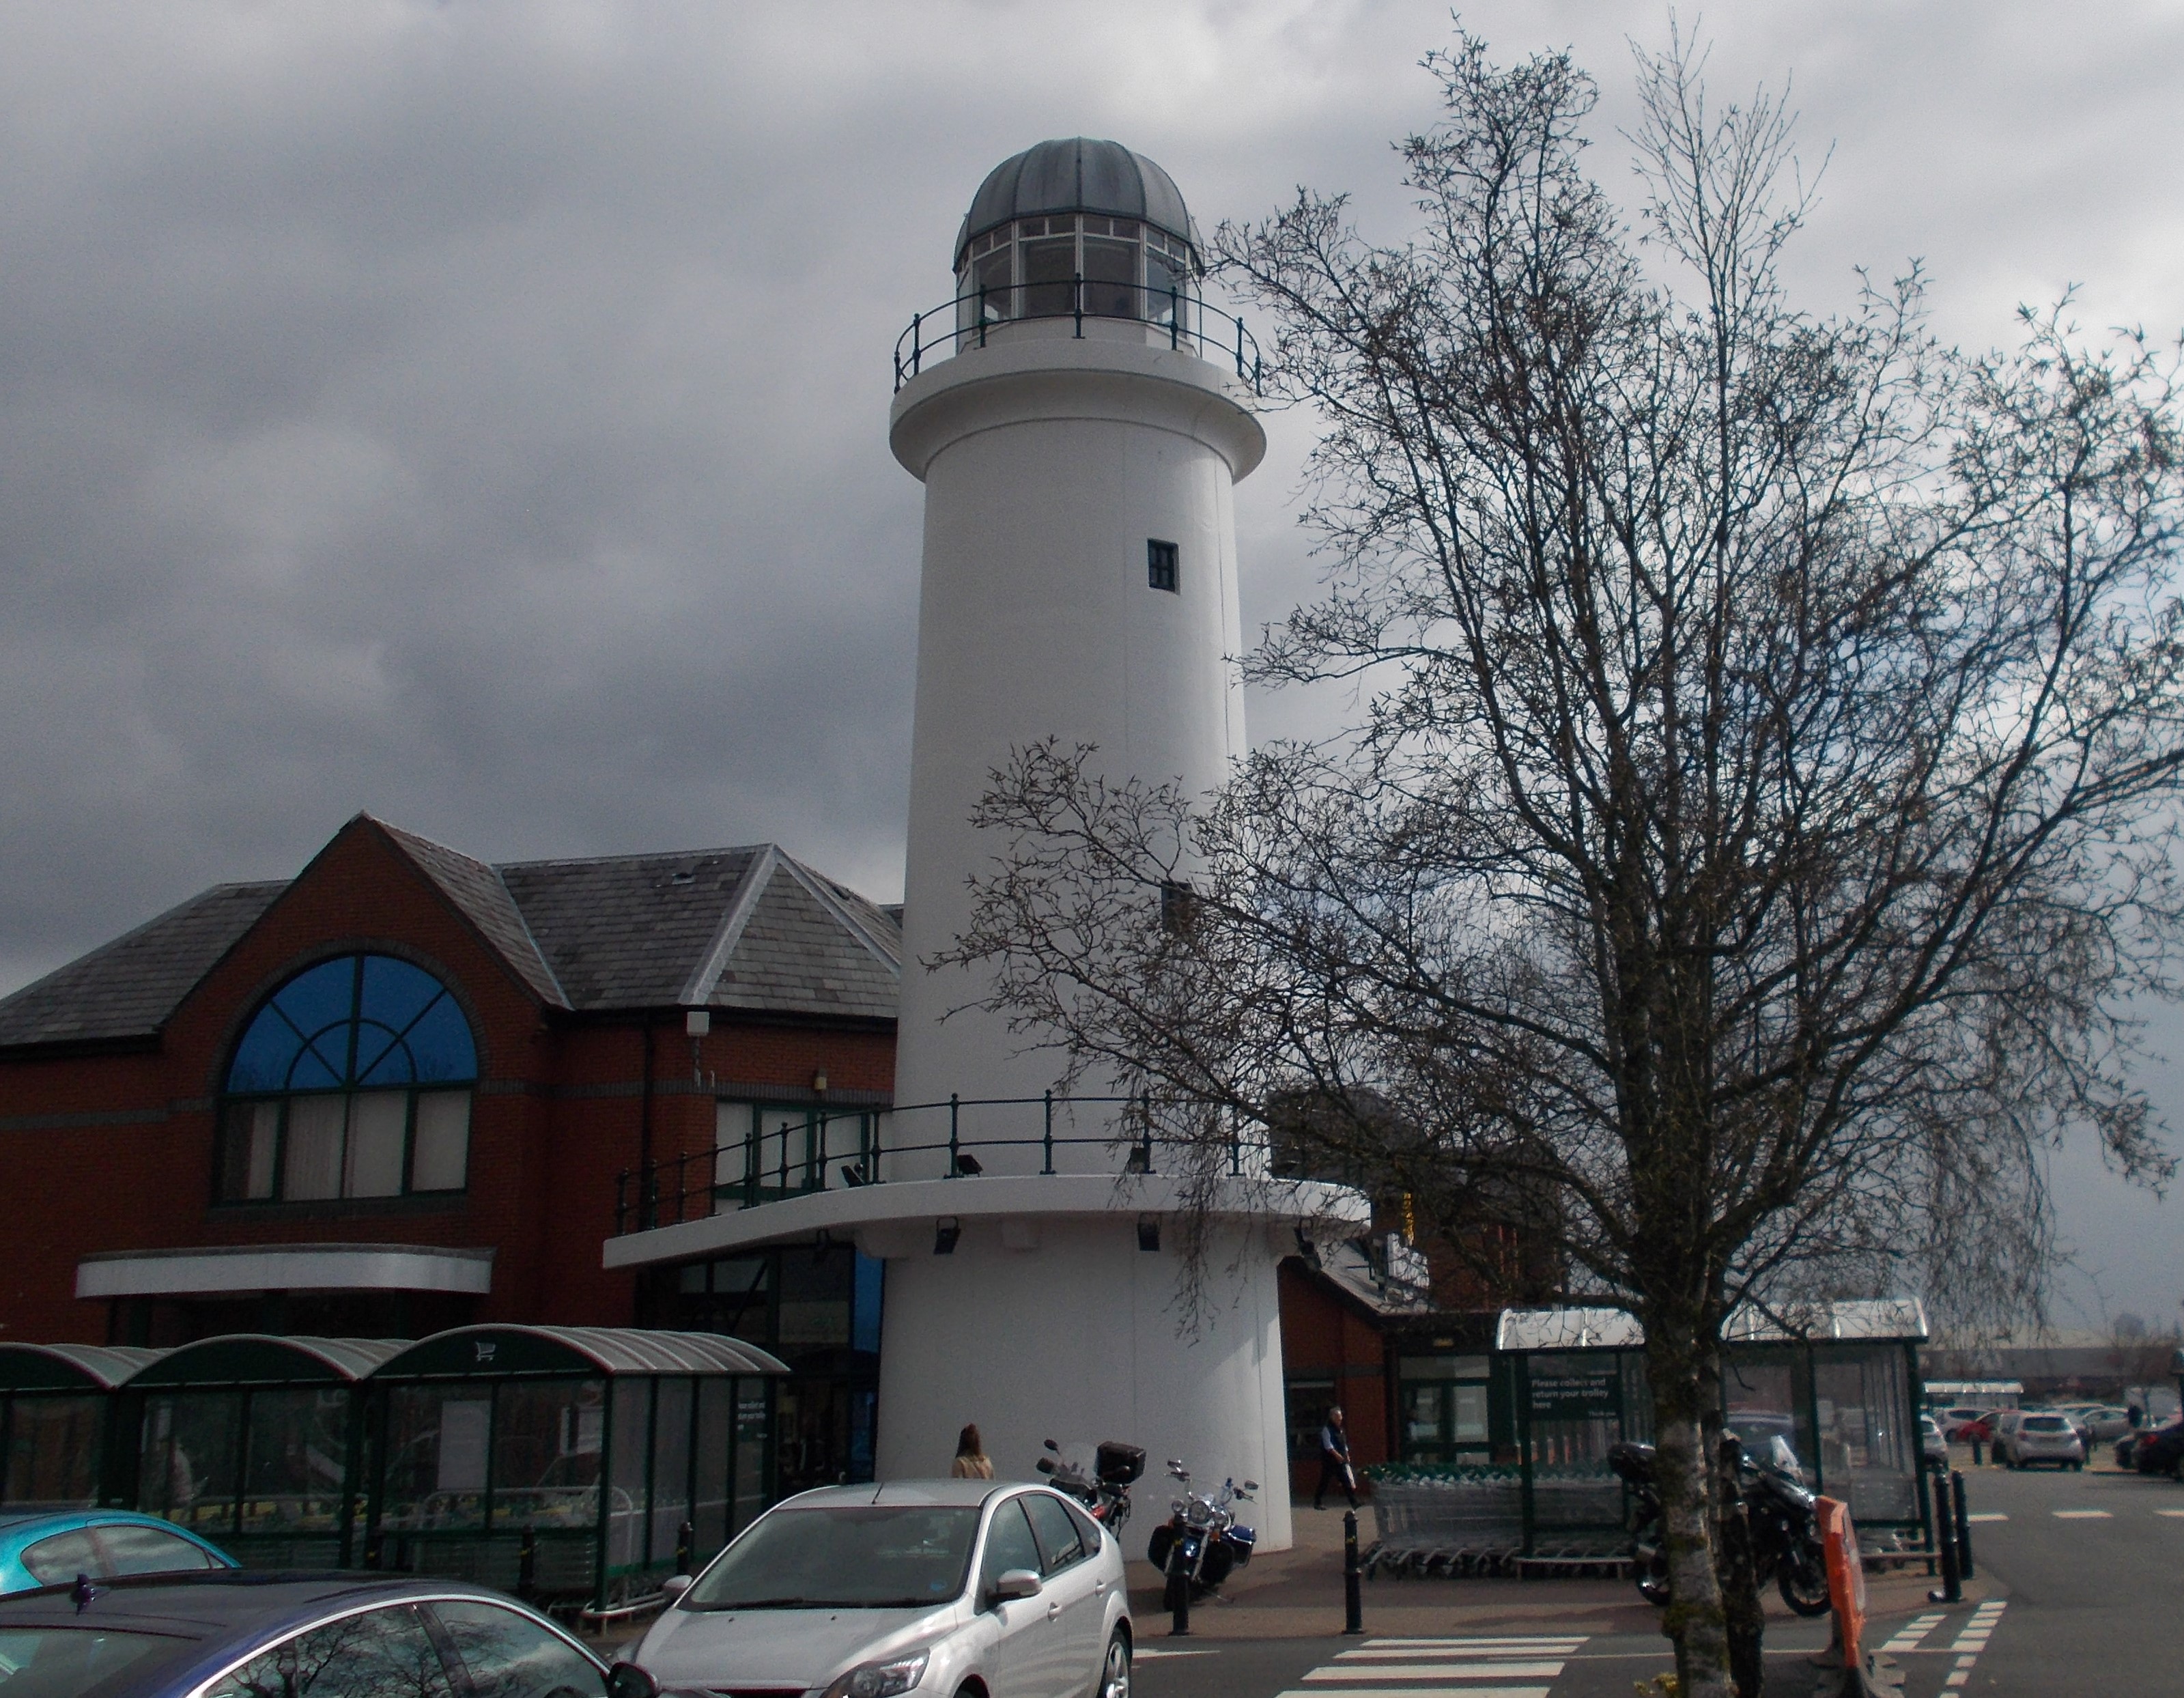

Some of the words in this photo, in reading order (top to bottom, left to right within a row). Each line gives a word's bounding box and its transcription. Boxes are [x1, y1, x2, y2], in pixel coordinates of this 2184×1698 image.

[1531, 1378, 1558, 1388] Please
[1590, 1377, 1606, 1387] and
[1560, 1391, 1579, 1400] your
[1581, 1387, 1608, 1399] trolley
[1532, 1400, 1551, 1409] here
